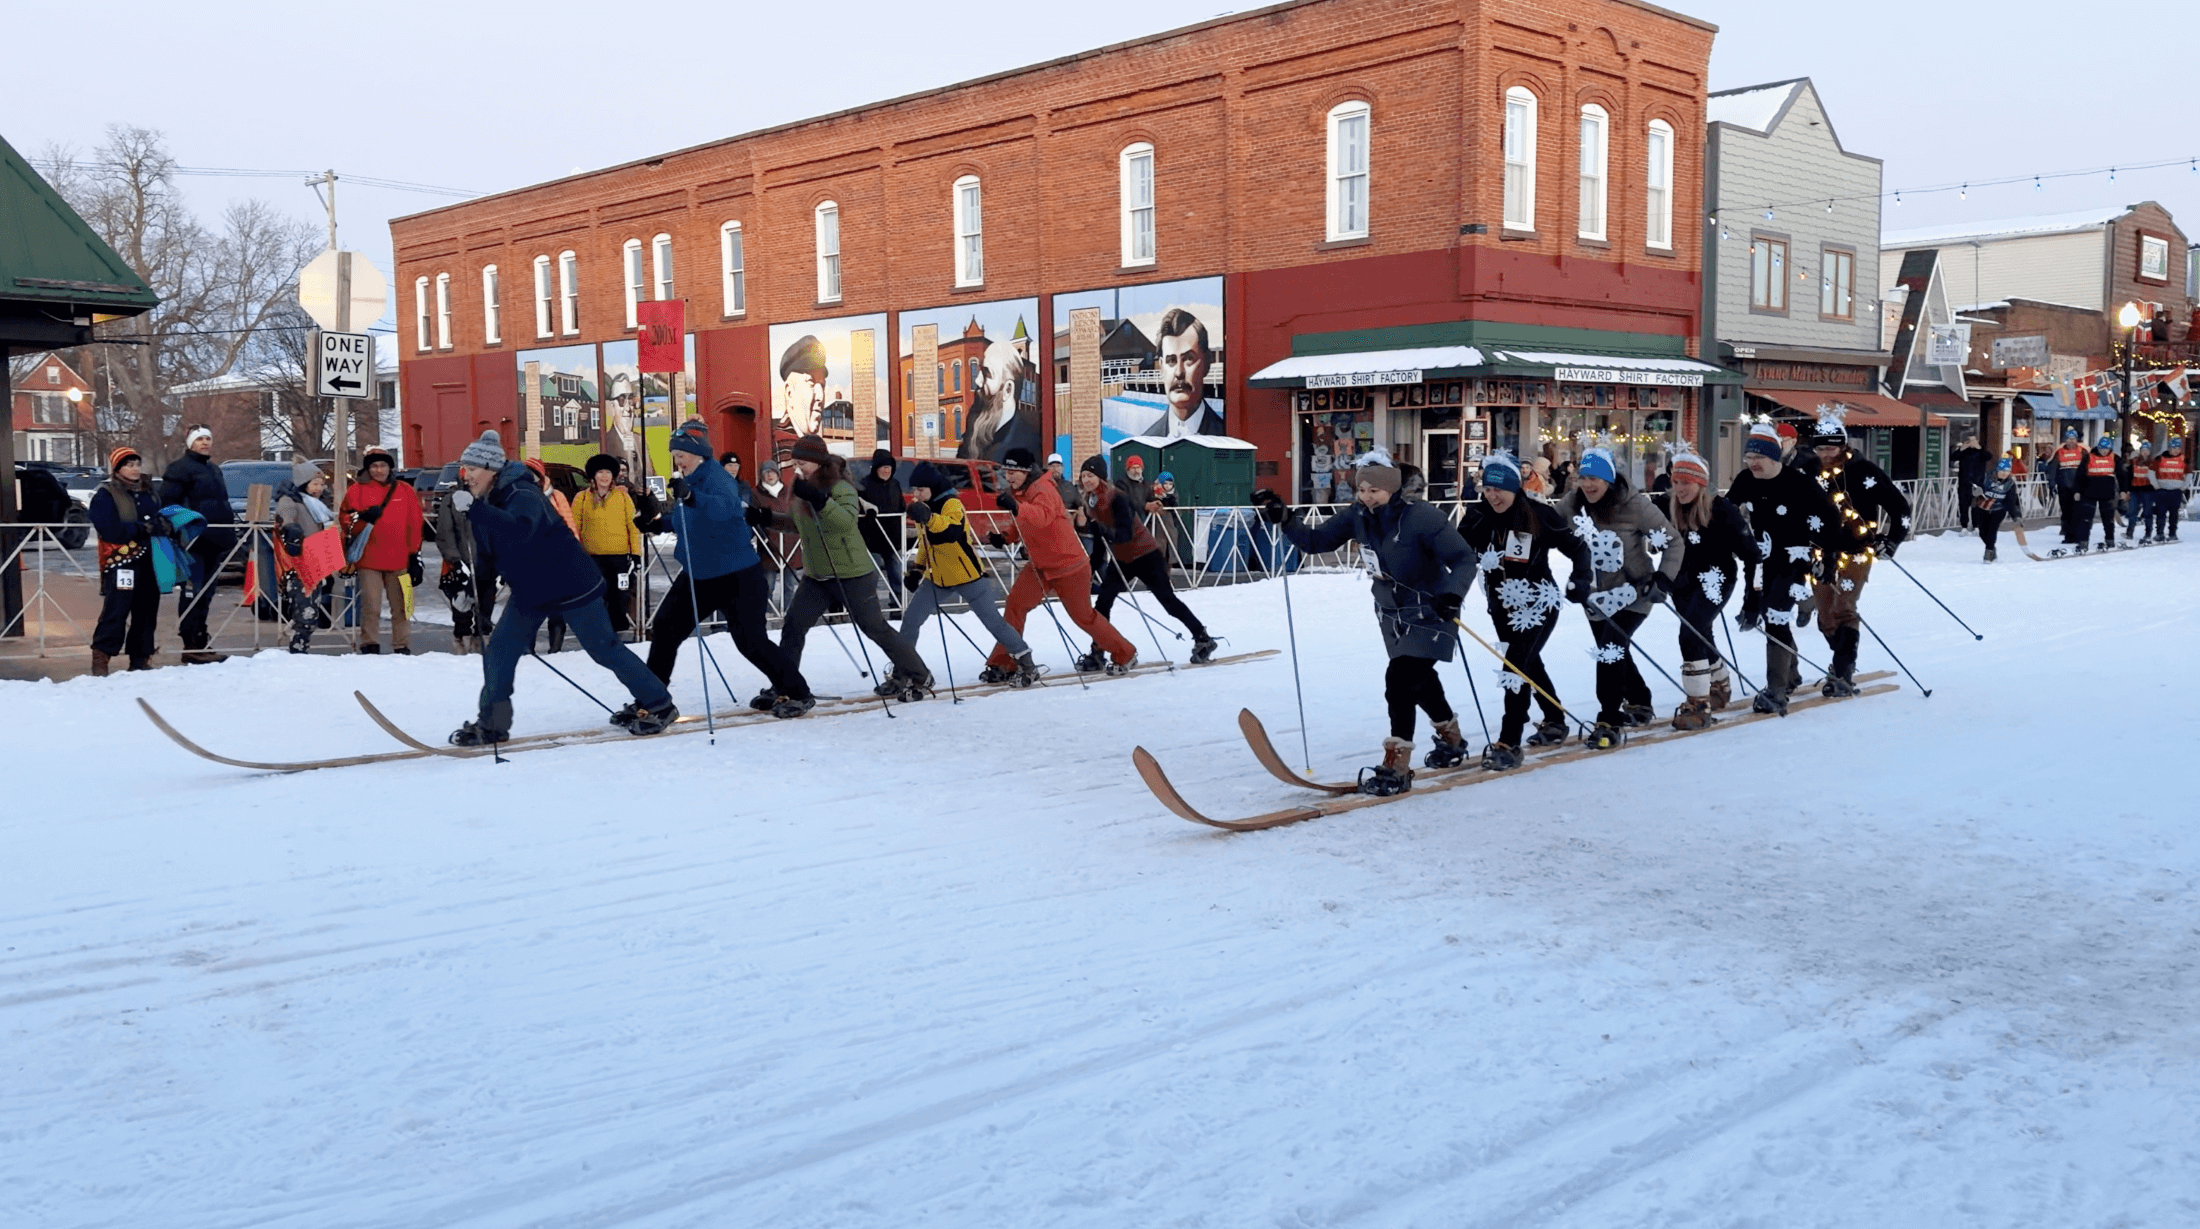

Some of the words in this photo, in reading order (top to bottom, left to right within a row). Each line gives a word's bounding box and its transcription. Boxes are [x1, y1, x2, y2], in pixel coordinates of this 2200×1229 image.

[325, 336, 364, 354] ONE
[325, 356, 364, 374] WAY
[2009, 356, 2038, 366] Shop
[1308, 376, 1347, 388] HAYWARD
[1351, 374, 1376, 385] SHIRT
[1380, 372, 1419, 383] FACTORY
[1559, 369, 1613, 381] HAYWARD
[1619, 371, 1650, 383] SHIRT
[1514, 545, 1523, 556] 3
[119, 578, 132, 586] 13
